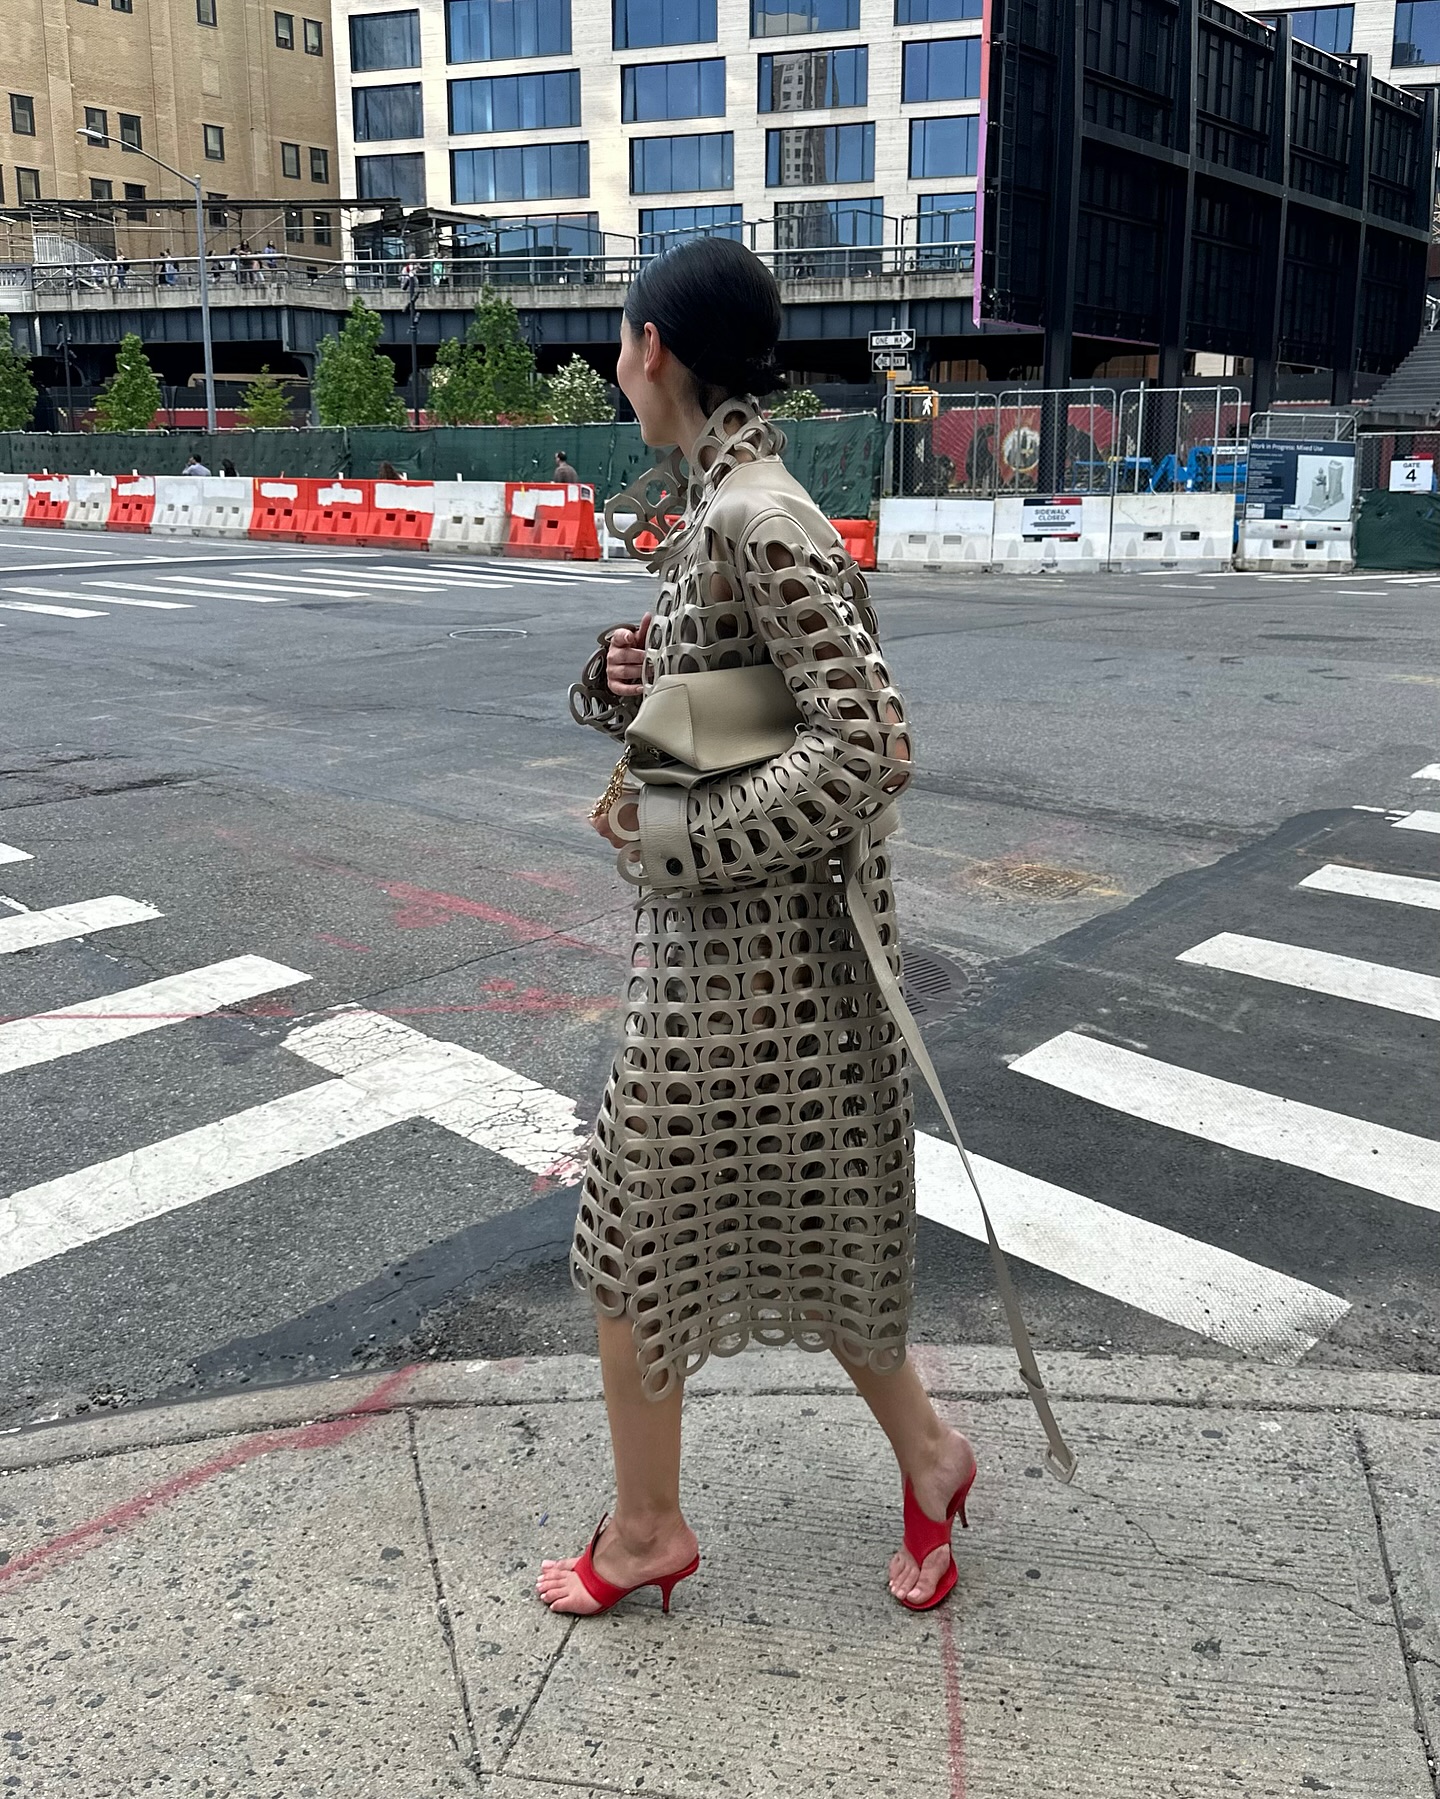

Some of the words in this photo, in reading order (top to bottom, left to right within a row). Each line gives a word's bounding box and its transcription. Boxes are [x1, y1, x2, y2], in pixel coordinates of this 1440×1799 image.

[875, 336, 888, 344] ONE
[878, 357, 888, 365] ONE
[1405, 469, 1417, 482] 4
